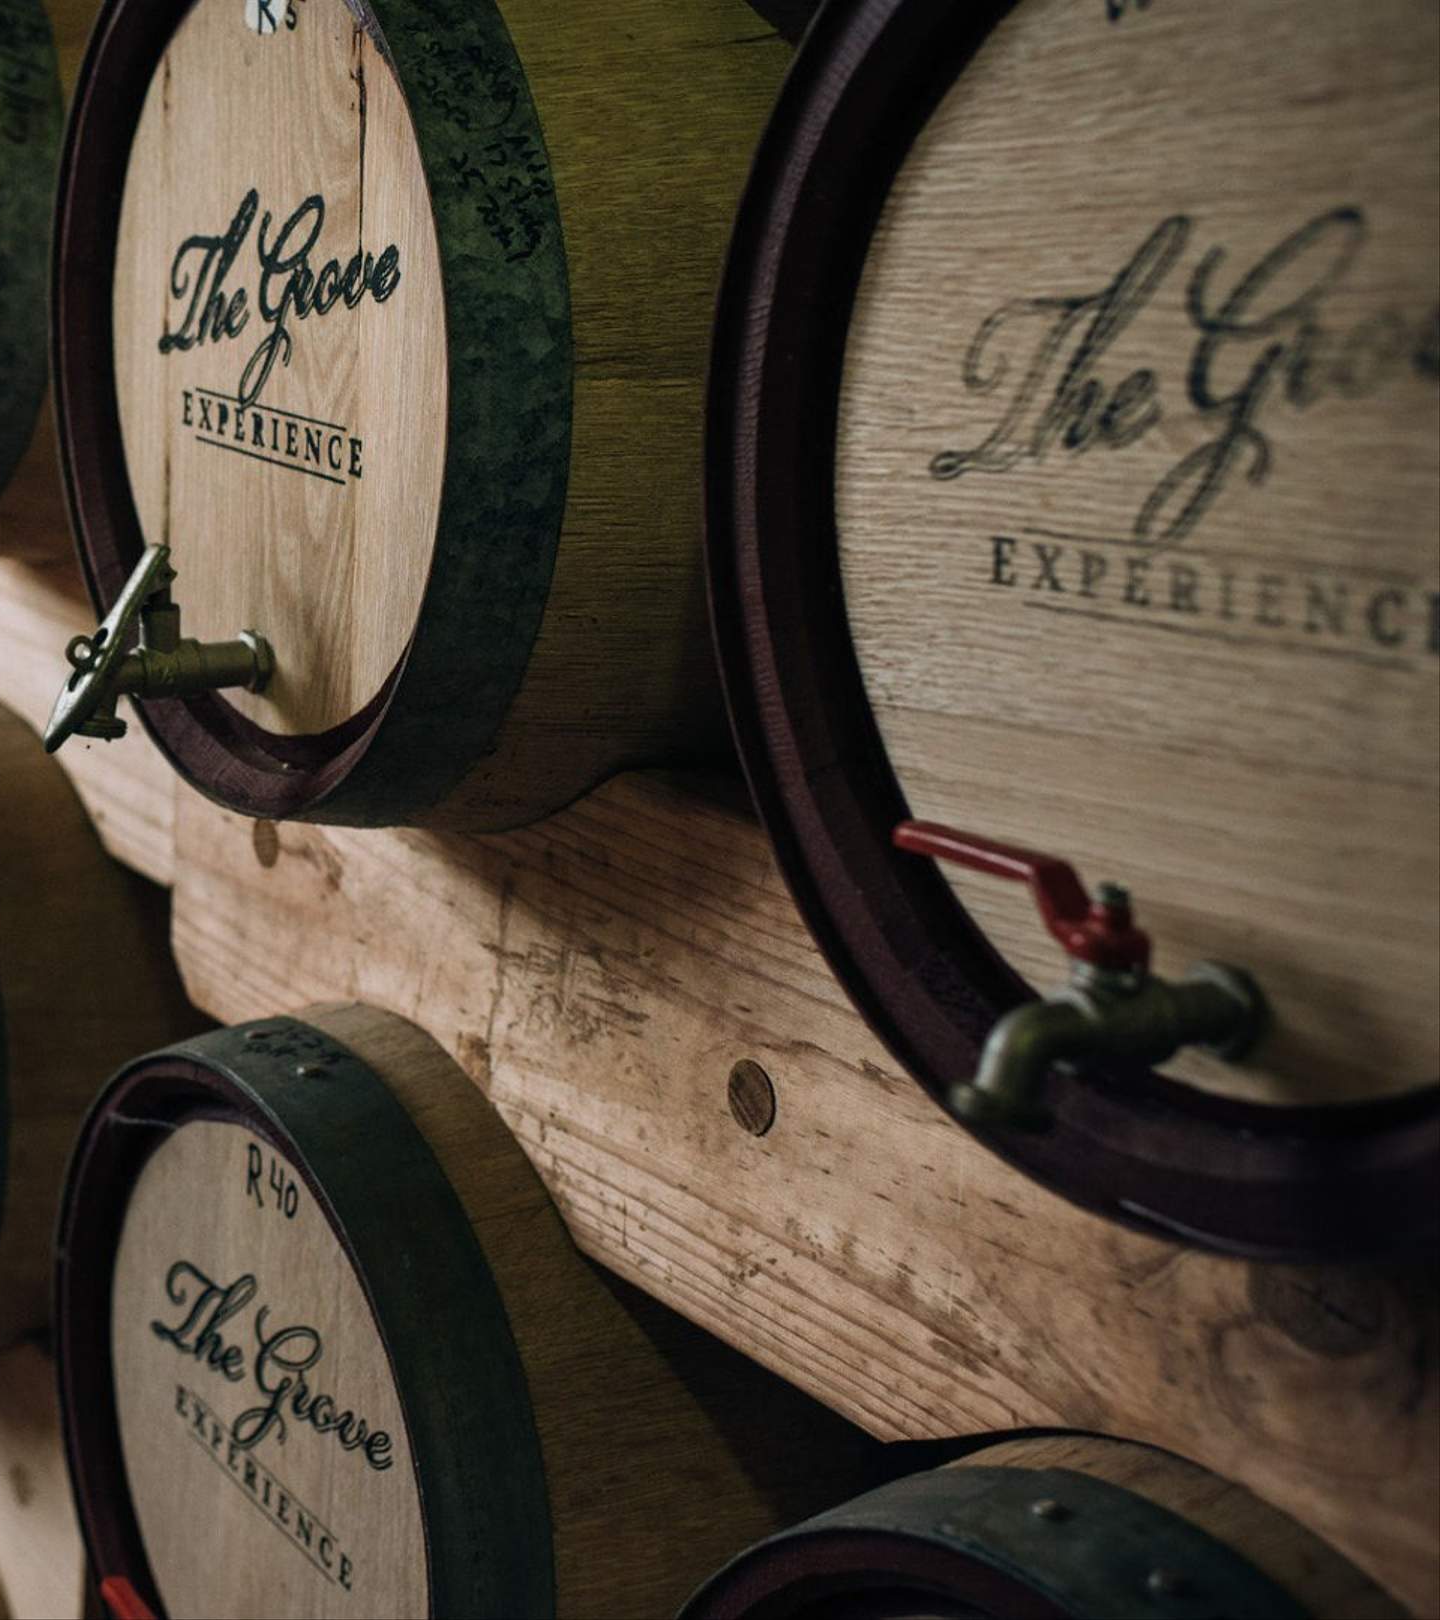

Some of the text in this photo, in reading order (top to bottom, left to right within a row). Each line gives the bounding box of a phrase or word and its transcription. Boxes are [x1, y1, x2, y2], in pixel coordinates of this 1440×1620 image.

[158, 188, 259, 354] The
[238, 194, 401, 409] Grove
[929, 213, 1192, 481] The
[182, 390, 364, 478] EXPERIENCE
[150, 1260, 394, 1471] The Grove
[175, 1385, 353, 1592] EXPERIENCE
